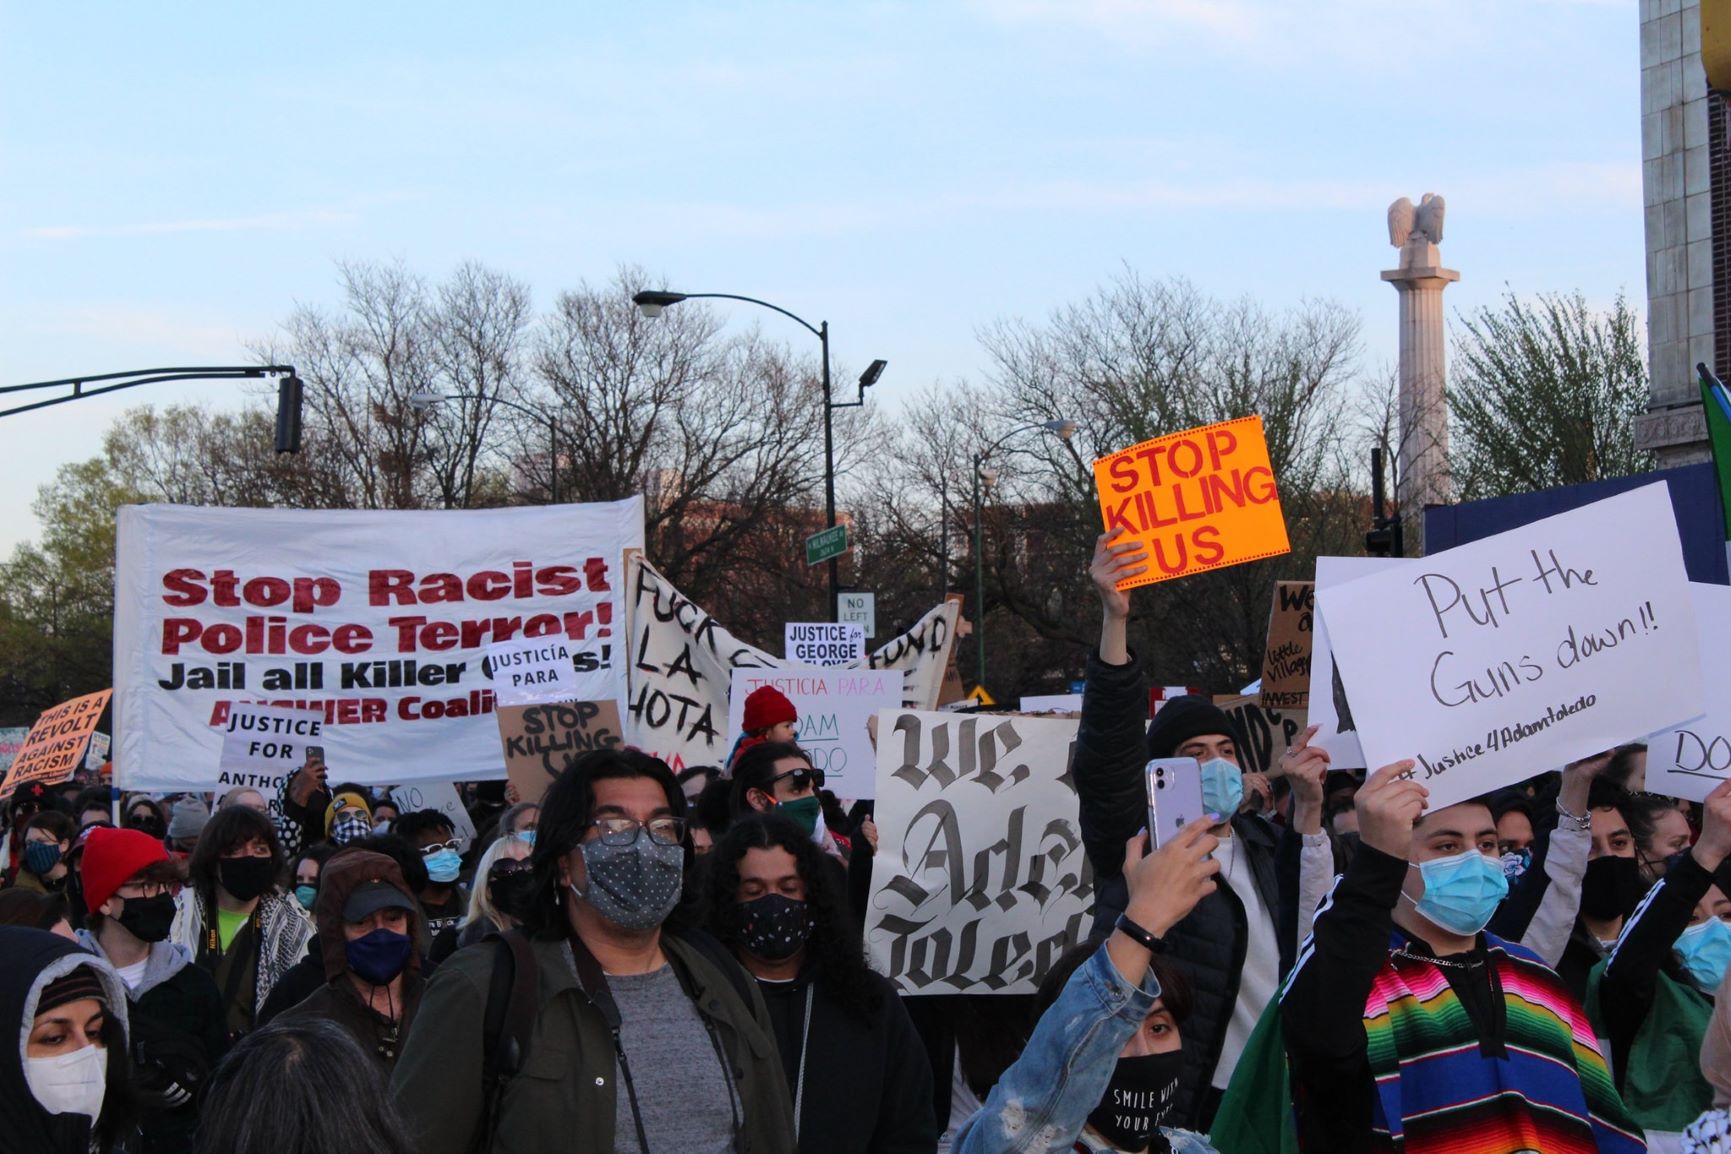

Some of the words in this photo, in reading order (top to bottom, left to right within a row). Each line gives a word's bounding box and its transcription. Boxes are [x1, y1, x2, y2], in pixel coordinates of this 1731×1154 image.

[1110, 430, 1237, 493] STOP
[1105, 466, 1279, 536] KILLING
[1152, 525, 1225, 575] US
[162, 569, 341, 613] Stop
[369, 558, 611, 606] Racist
[1414, 566, 1522, 639] Put
[1532, 549, 1598, 594] the
[843, 611, 868, 622] LEFT
[847, 598, 864, 609] NO
[161, 616, 373, 655] Police
[388, 602, 612, 653] Terror!
[790, 626, 847, 642] JUSTICE
[850, 628, 862, 643] for
[492, 643, 569, 672] JUSTICÍA
[636, 624, 708, 690] LA
[795, 643, 857, 660] GEORGE
[1430, 651, 1544, 707] Guns
[1557, 602, 1658, 669] down!!
[158, 662, 245, 691] Jail
[262, 662, 323, 690] all
[341, 660, 466, 688] Killer
[512, 669, 559, 687] PARA
[838, 678, 885, 696] PARA
[39, 705, 71, 726] THIS
[73, 700, 90, 715] IS
[92, 697, 104, 710] A
[398, 689, 496, 720] Coali
[522, 701, 600, 734] STOP
[26, 712, 97, 747] REVOLT
[227, 713, 321, 737] JUSTICE
[16, 735, 88, 764] AGAINST
[249, 742, 293, 759] FOR
[506, 728, 621, 758] KILLING
[13, 752, 75, 780] RACISM
[396, 787, 424, 814] NO
[1114, 1089, 1155, 1109] SMILE
[1115, 1115, 1149, 1132] YOUR
